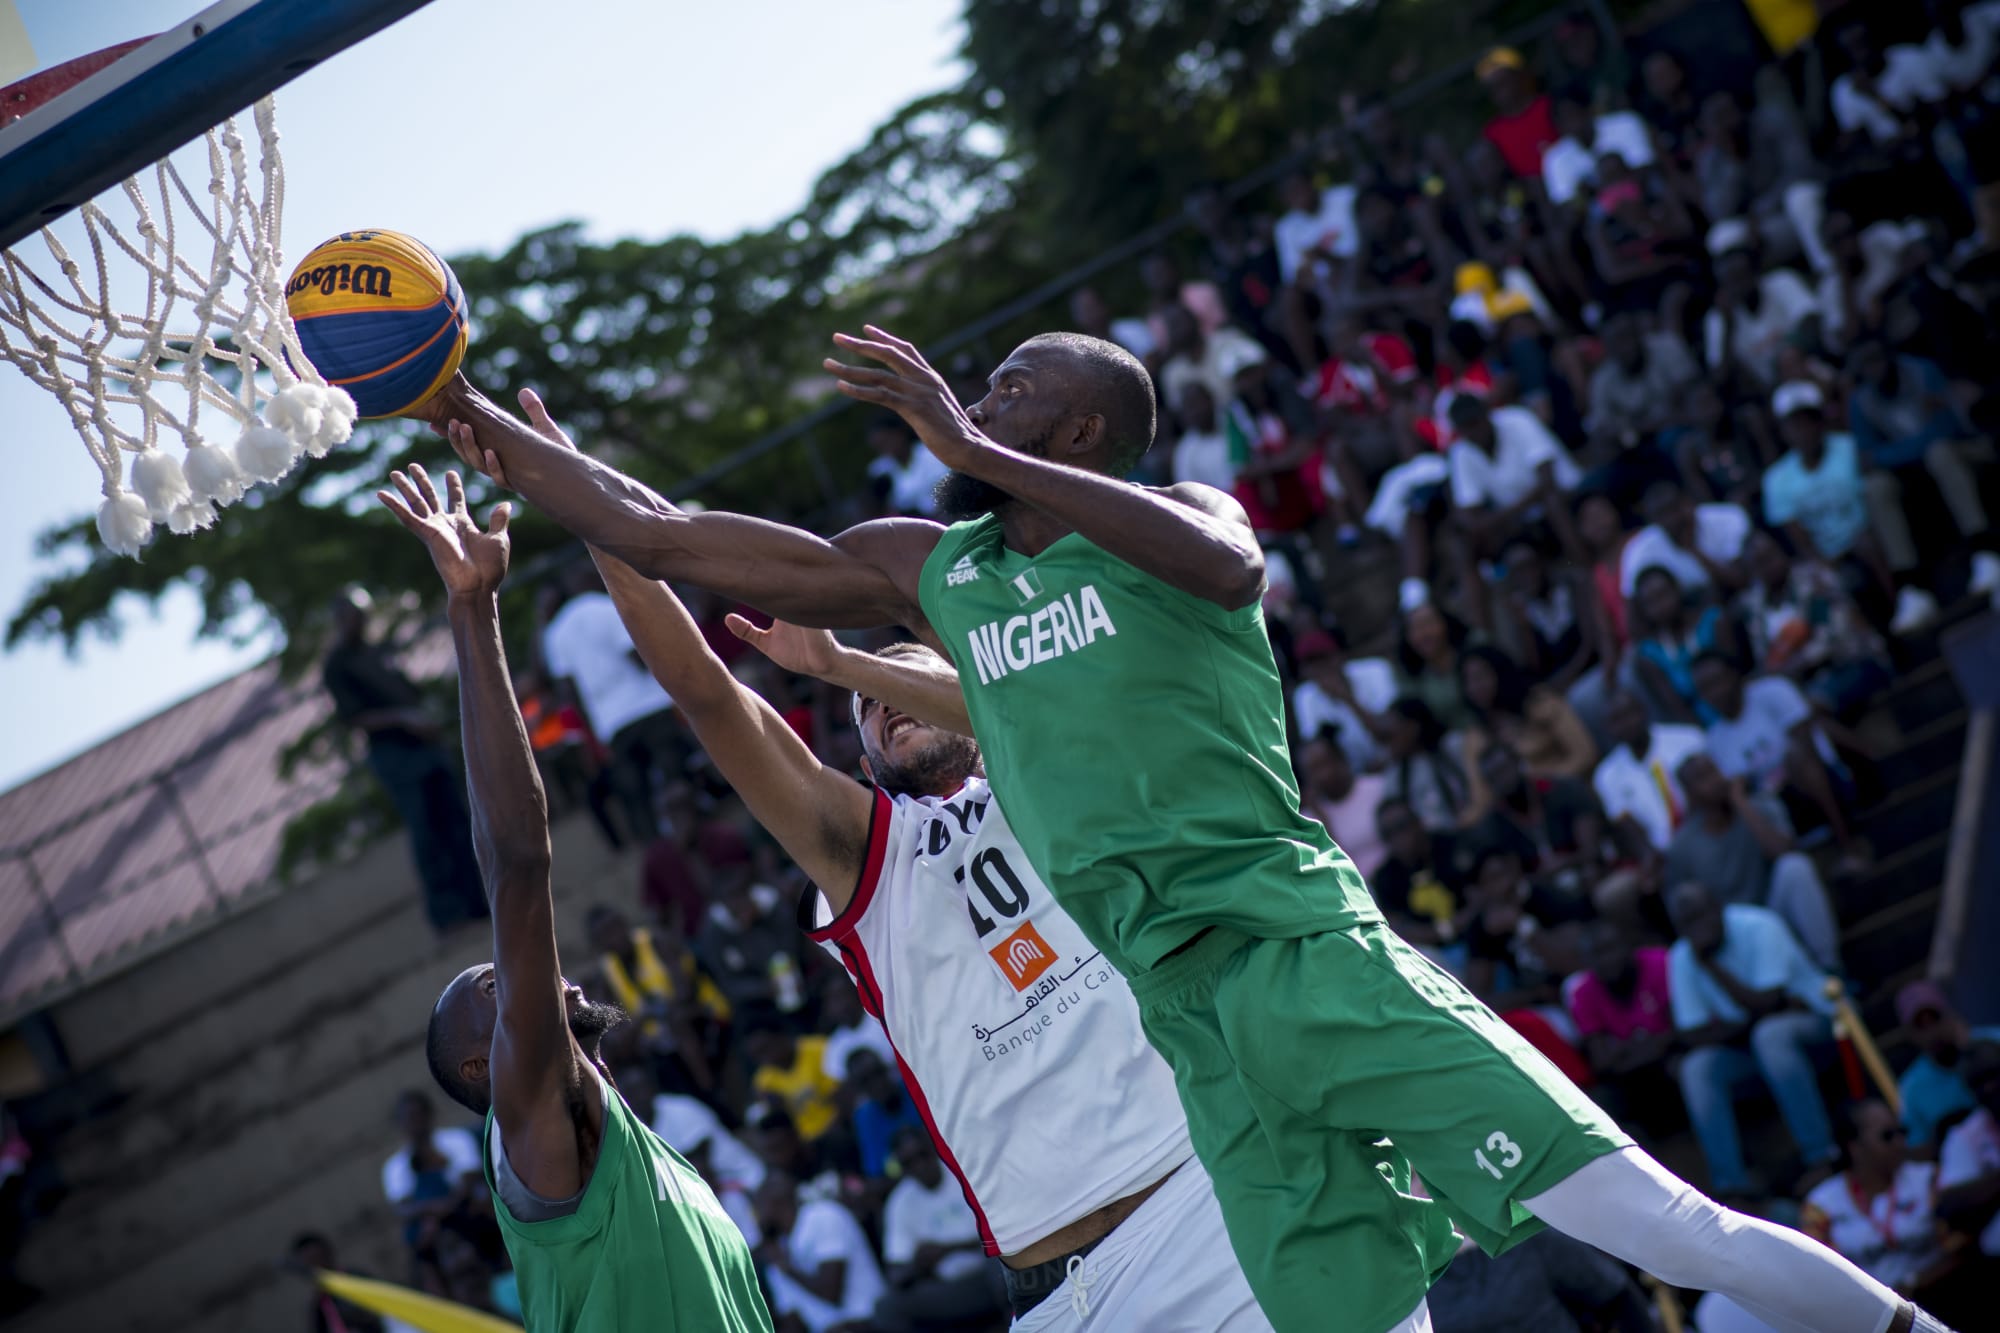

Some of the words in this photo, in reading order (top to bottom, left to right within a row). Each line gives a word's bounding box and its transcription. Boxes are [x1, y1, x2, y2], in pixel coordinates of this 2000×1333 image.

[284, 263, 392, 299] Wilson
[946, 567, 979, 587] PEAK
[967, 584, 1118, 686] NIGERIA
[981, 1013, 1053, 1062] Banque
[1056, 991, 1081, 1015] du
[1474, 1130, 1523, 1181] 13
